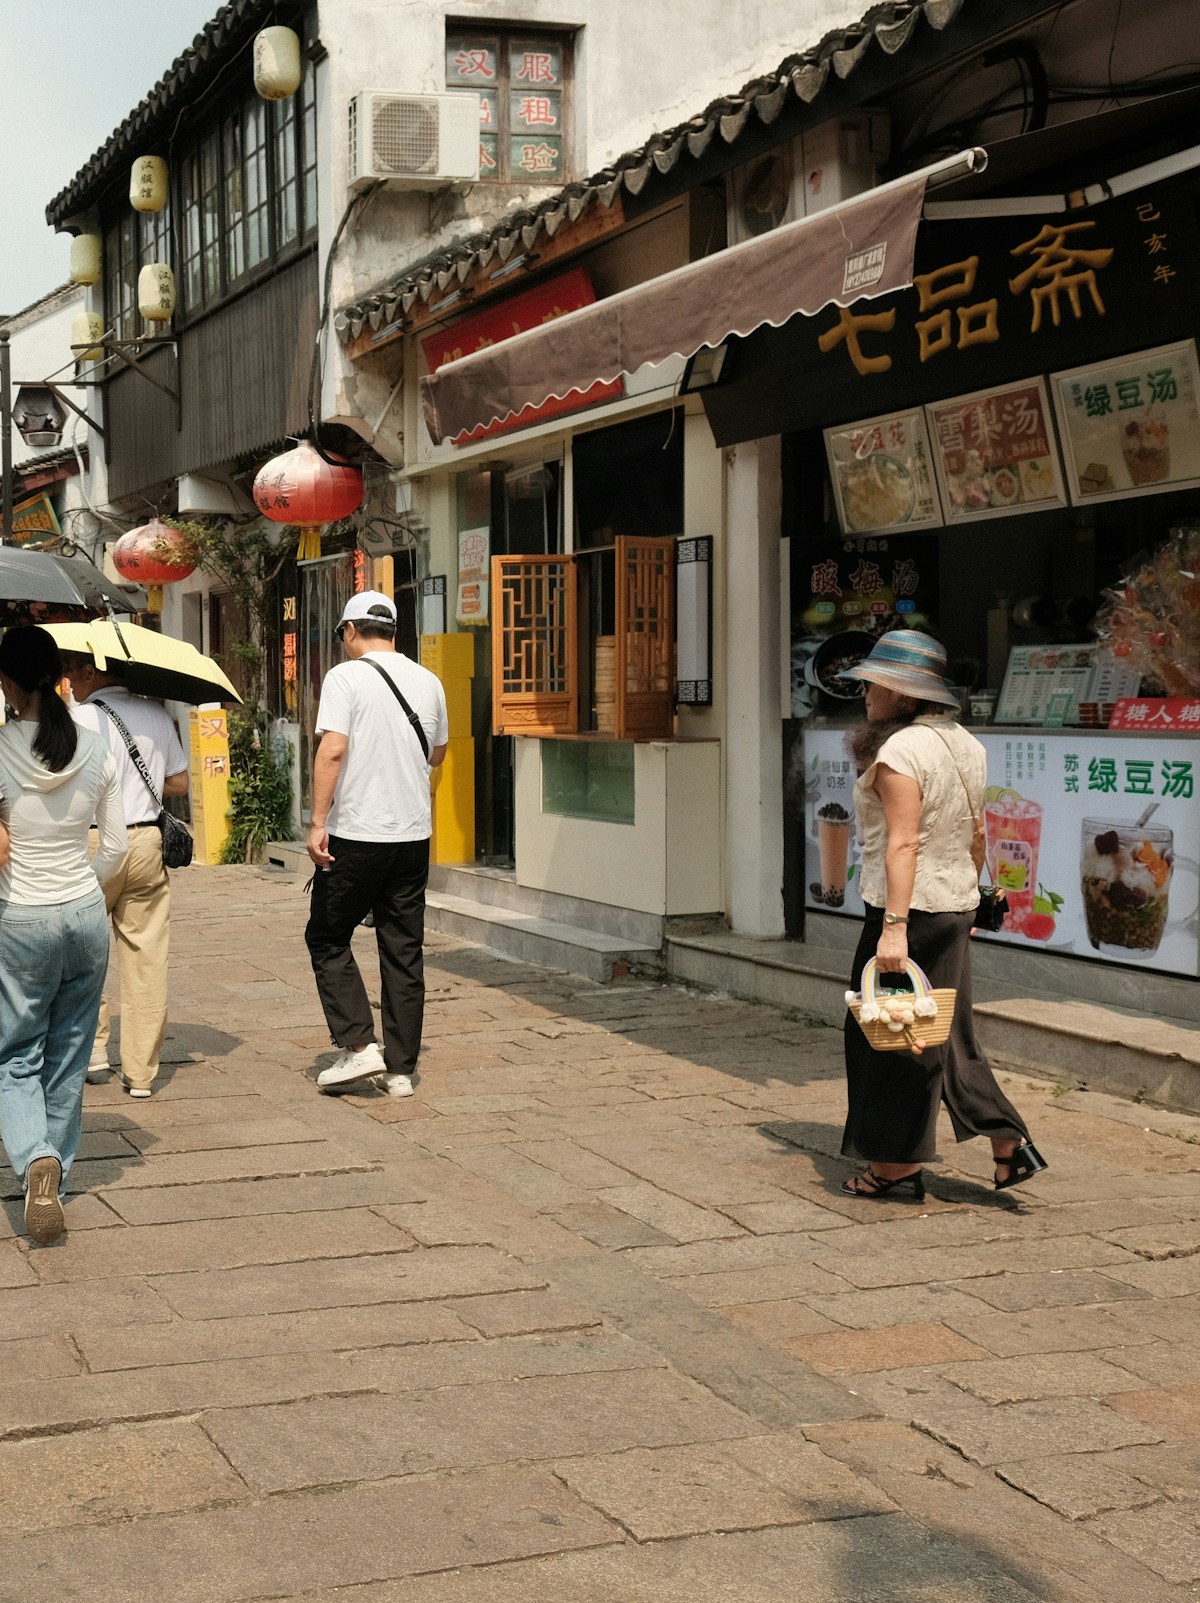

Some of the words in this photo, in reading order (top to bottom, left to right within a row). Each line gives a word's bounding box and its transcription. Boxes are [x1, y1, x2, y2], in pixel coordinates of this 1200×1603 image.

[455, 49, 557, 83] 汉服
[141, 160, 154, 199] 汉服馆
[1135, 203, 1176, 285] 己亥年
[159, 270, 171, 309] 汉服馆
[818, 221, 1114, 375] 七品斋
[1084, 367, 1178, 417] 绿豆汤
[939, 397, 1038, 452] 雪梨汤
[254, 473, 287, 490] 芳集
[256, 496, 290, 511] 服馆
[811, 558, 920, 597] 酸梅汤
[1124, 703, 1200, 723] 糖人糖
[1027, 742, 1035, 780] 新鲜芭乐
[1064, 753, 1079, 794] 苏式
[1088, 756, 1194, 799] 绿豆汤
[827, 776, 846, 789] 奶茶
